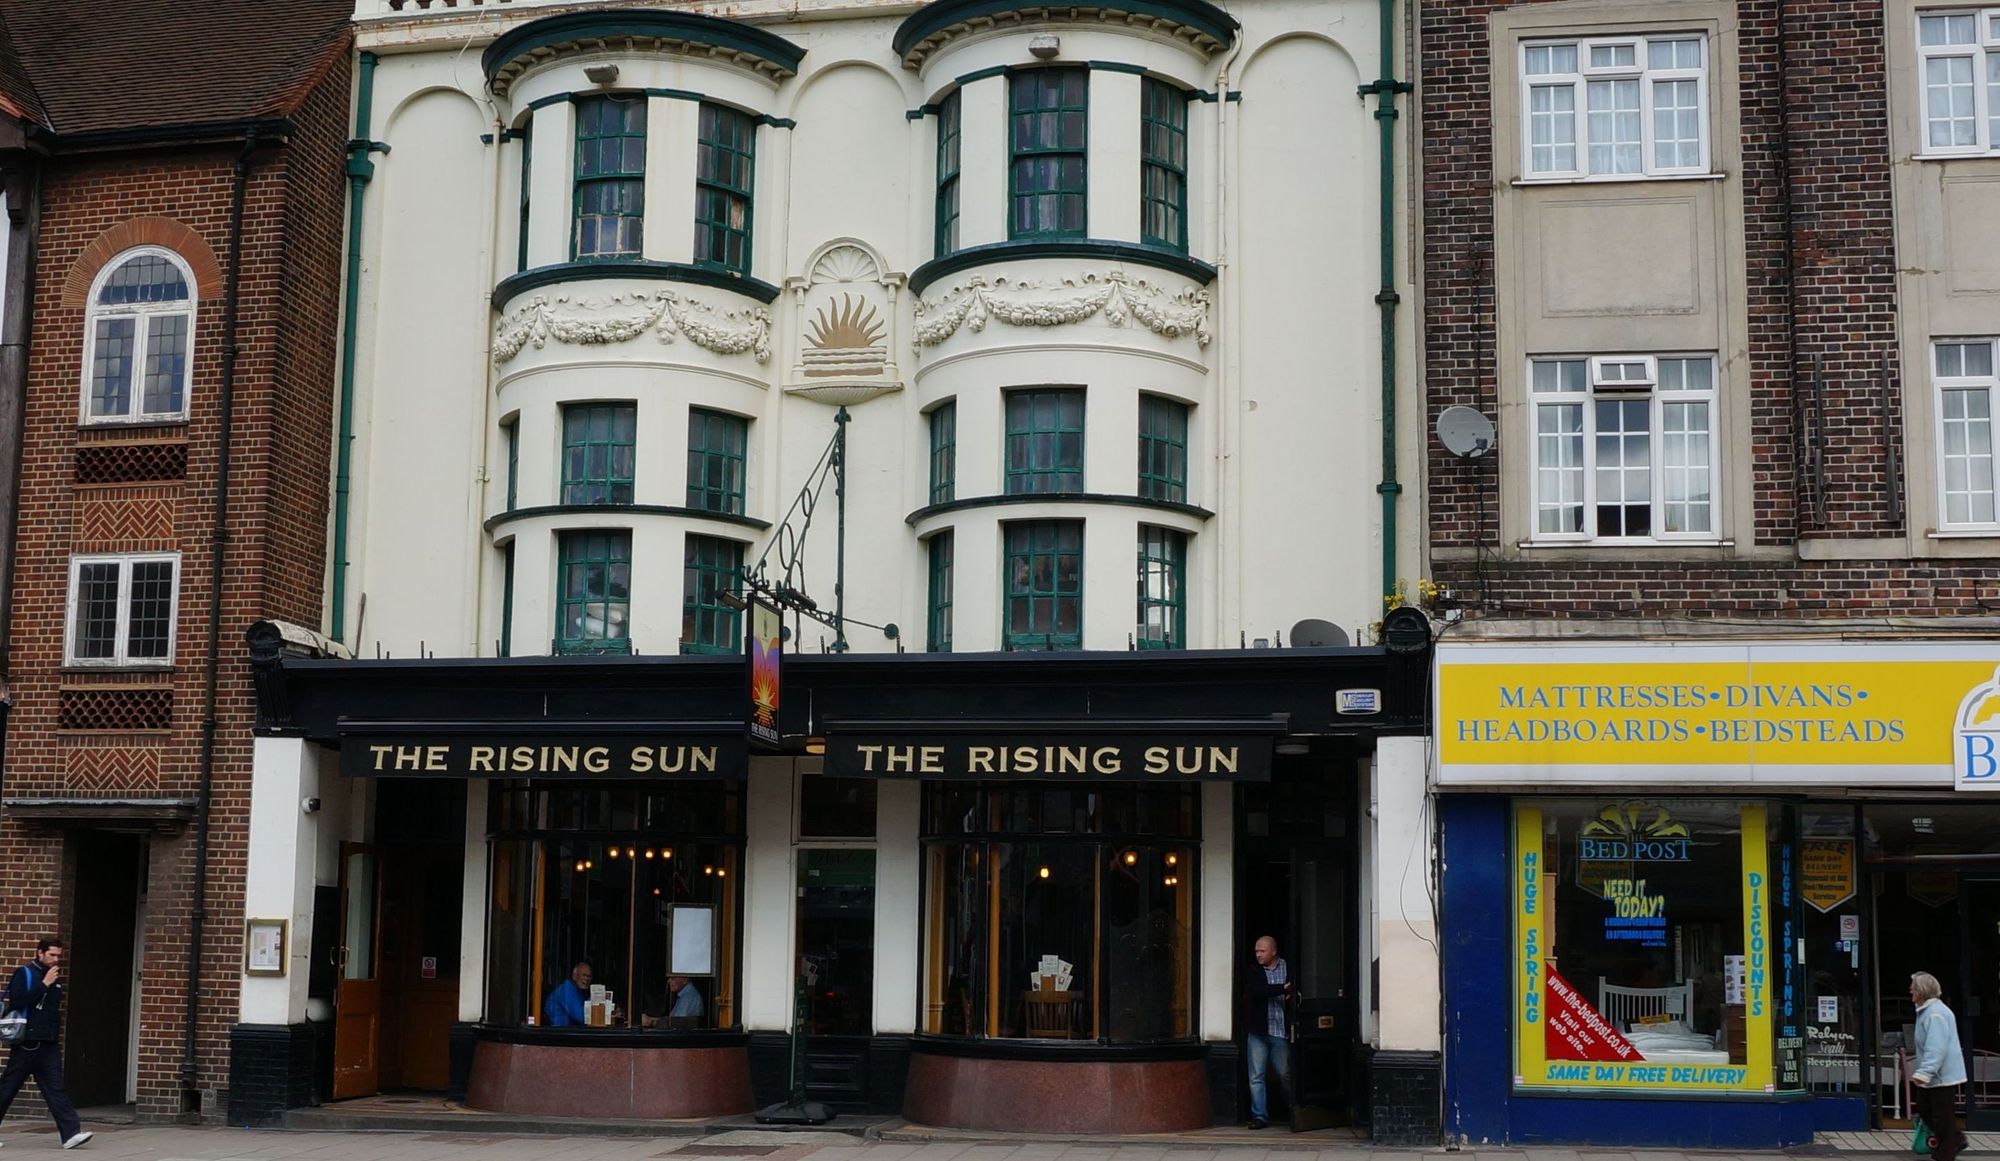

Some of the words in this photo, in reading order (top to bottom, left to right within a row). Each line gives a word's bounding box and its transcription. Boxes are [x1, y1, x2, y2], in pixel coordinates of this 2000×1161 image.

[1499, 685, 1707, 708] MATTRESSES
[1726, 685, 1853, 708] DIVANS
[1456, 719, 1689, 742] HEADBOARDS
[1709, 719, 1905, 743] BEDSTEADS
[370, 745, 449, 772] THE
[468, 745, 610, 774] RISING
[629, 745, 719, 774] SUN
[857, 745, 945, 773] THE
[967, 745, 1122, 774] RISING
[1143, 746, 1239, 774] SUN
[1579, 839, 1629, 859] BED
[1632, 839, 1692, 860] POST
[1524, 852, 1537, 914] HUGE
[1782, 844, 1791, 907] HUGE
[1603, 879, 1633, 900] NEED
[1635, 879, 1647, 899] IT
[1614, 895, 1665, 918] TODAY?
[1748, 872, 1764, 1016] DISCOUNTS
[1525, 928, 1539, 1023] SPRING
[1783, 921, 1792, 1017] SPRING
[1547, 975, 1632, 1058] www.the-bedpost.co.uk
[1549, 1016, 1568, 1036] web
[1559, 1010, 1580, 1031] Visit
[1579, 1029, 1595, 1046] our
[1778, 1037, 1803, 1049] DELIVERY
[1783, 1026, 1796, 1037] FREE
[1806, 1025, 1855, 1041] Relyon
[1786, 1049, 1794, 1059] IN
[1818, 1041, 1846, 1055] Sealy
[1548, 1065, 1591, 1081] SAME
[1595, 1066, 1625, 1081] DAY
[1628, 1067, 1667, 1082] FREE
[1671, 1068, 1746, 1084] DELIVERY
[1784, 1060, 1797, 1071] VAN
[1783, 1072, 1798, 1083] AREA
